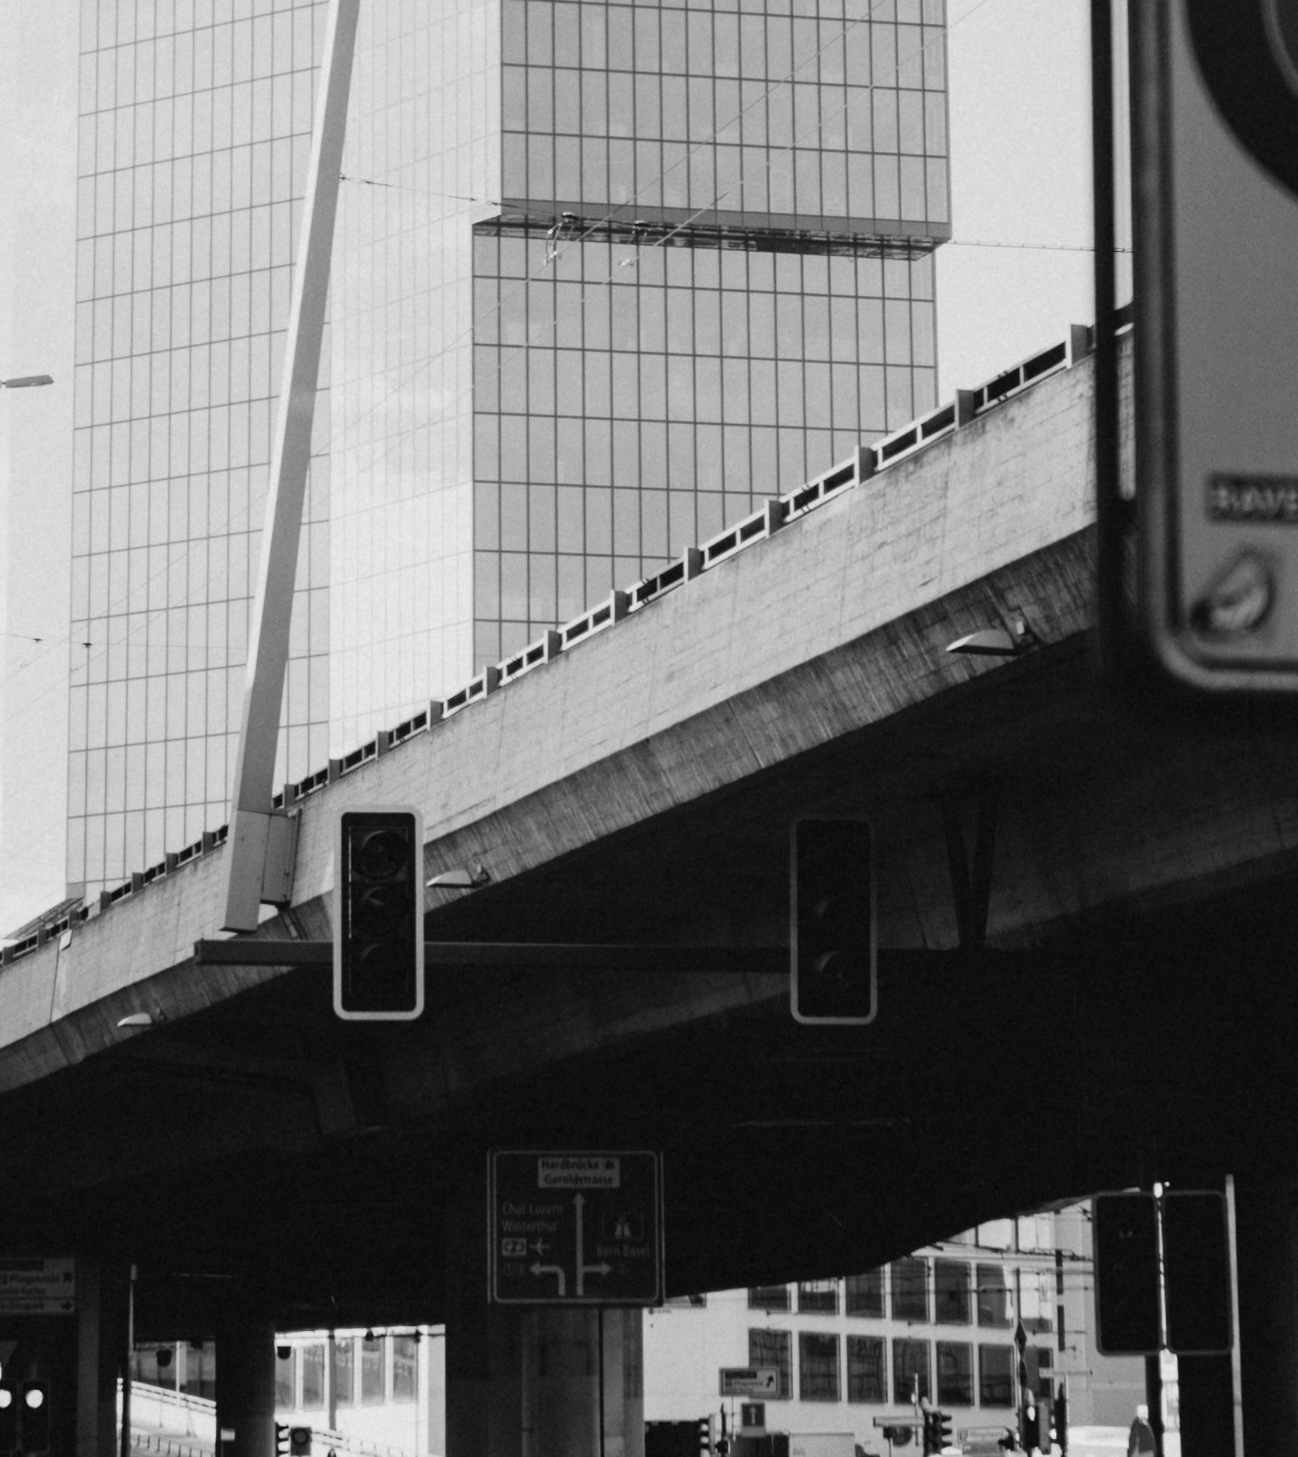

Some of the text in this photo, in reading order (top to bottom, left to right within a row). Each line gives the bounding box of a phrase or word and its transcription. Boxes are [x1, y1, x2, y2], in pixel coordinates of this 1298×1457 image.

[543, 1174, 614, 1186] Geroldstrasse
[502, 1202, 563, 1216] Chur Luzern
[502, 1219, 558, 1234] Winterthur
[596, 1244, 650, 1258] Bern Basel
